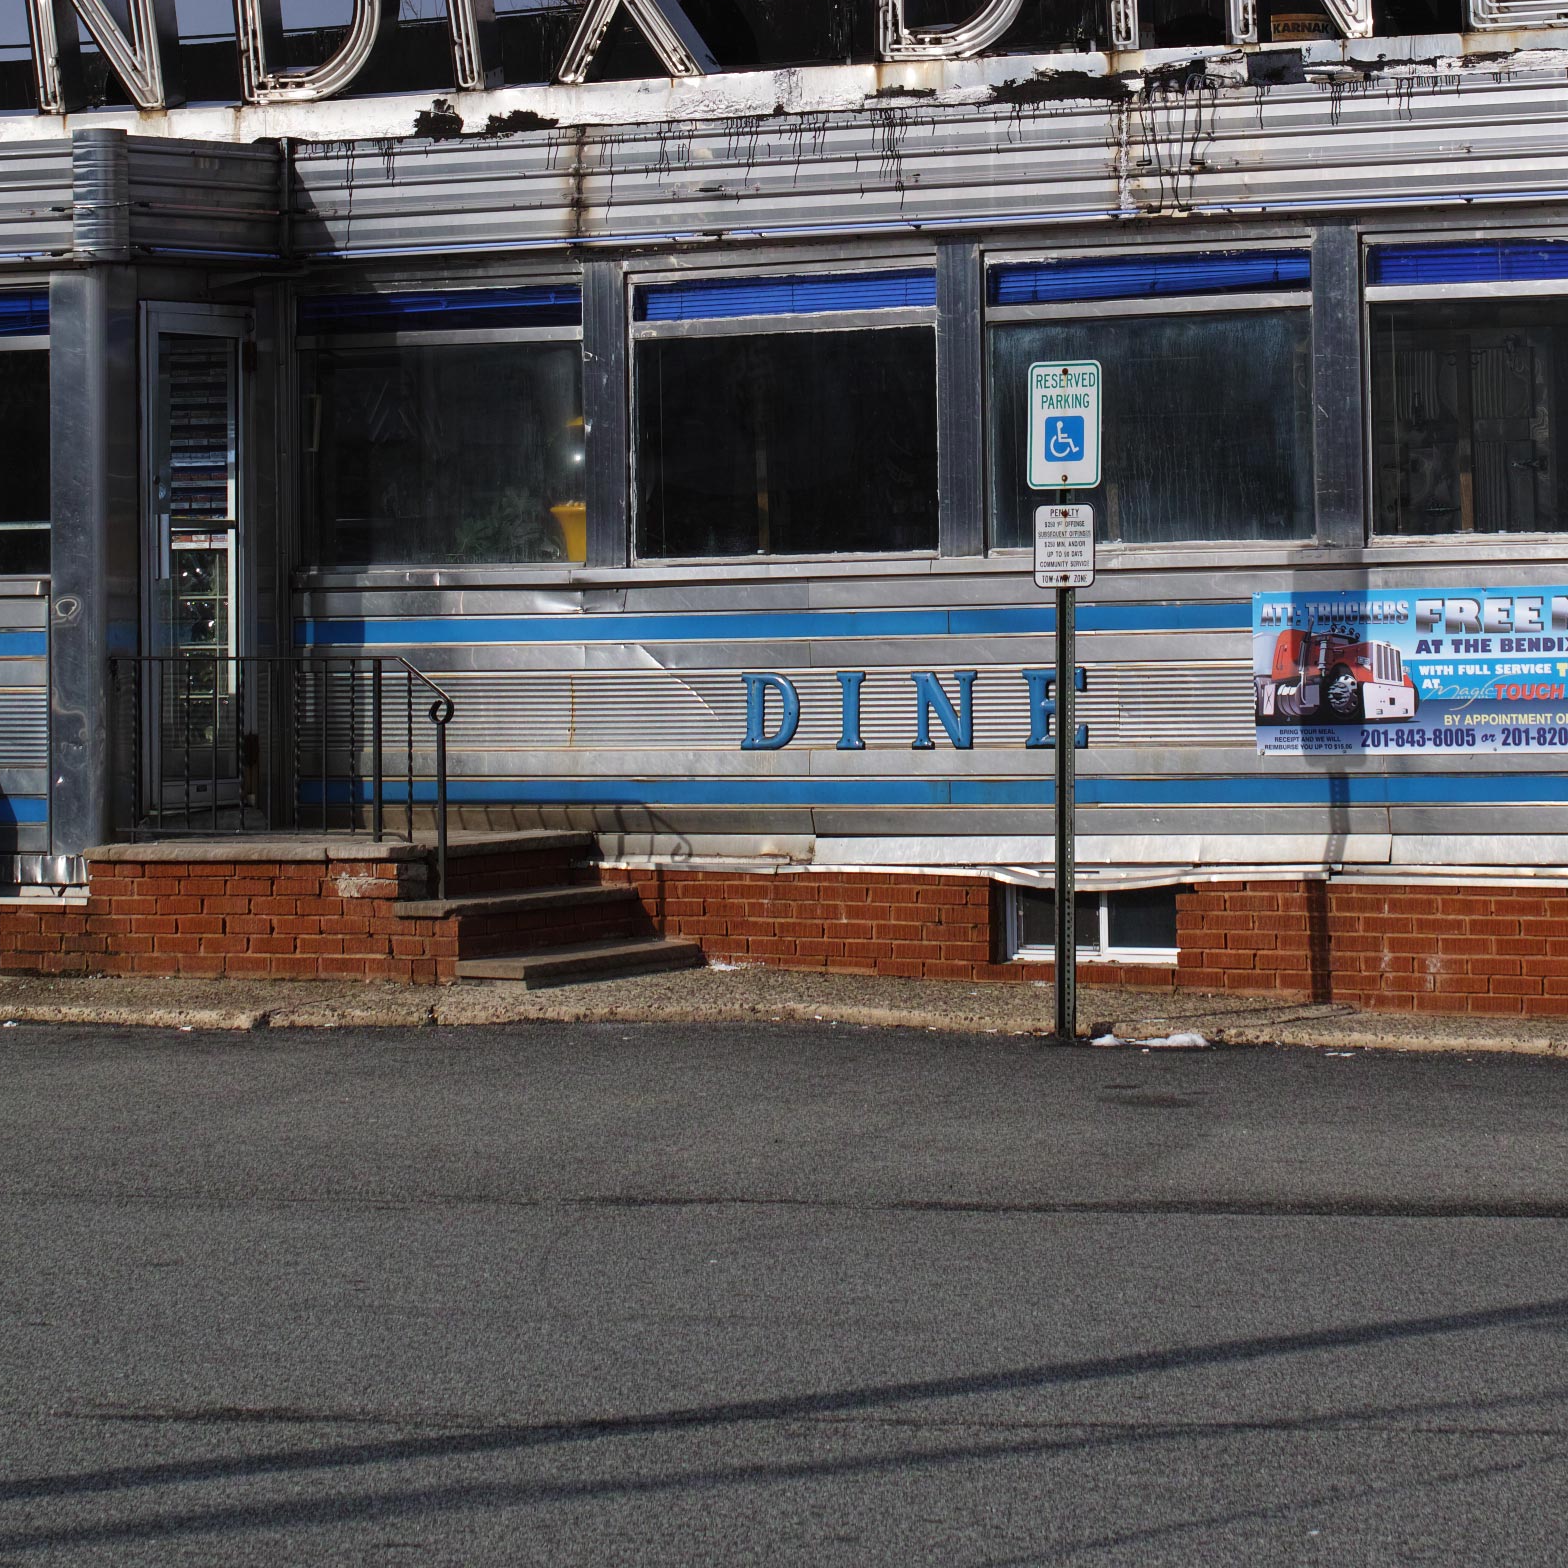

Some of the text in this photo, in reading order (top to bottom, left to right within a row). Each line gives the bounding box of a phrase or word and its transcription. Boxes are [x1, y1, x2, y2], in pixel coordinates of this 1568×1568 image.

[1273, 22, 1330, 34] KARNAK
[1036, 372, 1096, 389] RESERVED
[1041, 393, 1090, 410] PARKING
[1050, 509, 1079, 517] PENLTY
[1042, 575, 1070, 583] TOW-AWY
[1260, 600, 1409, 626] ATT: TRUCKERS
[1415, 597, 1545, 634] FREE
[1415, 640, 1444, 654] AT
[1451, 638, 1492, 653] THE
[1418, 665, 1454, 676] WITH
[1457, 665, 1491, 675] FULL
[1495, 663, 1552, 675] SERVICE
[1422, 678, 1441, 688] AT
[1494, 683, 1565, 701] TOUCH
[741, 666, 1088, 750] DINE
[1444, 715, 1461, 725] BY
[1464, 714, 1553, 725] APPOINTMENT
[1360, 728, 1476, 747] 201-843-8005
[1480, 732, 1497, 742] or
